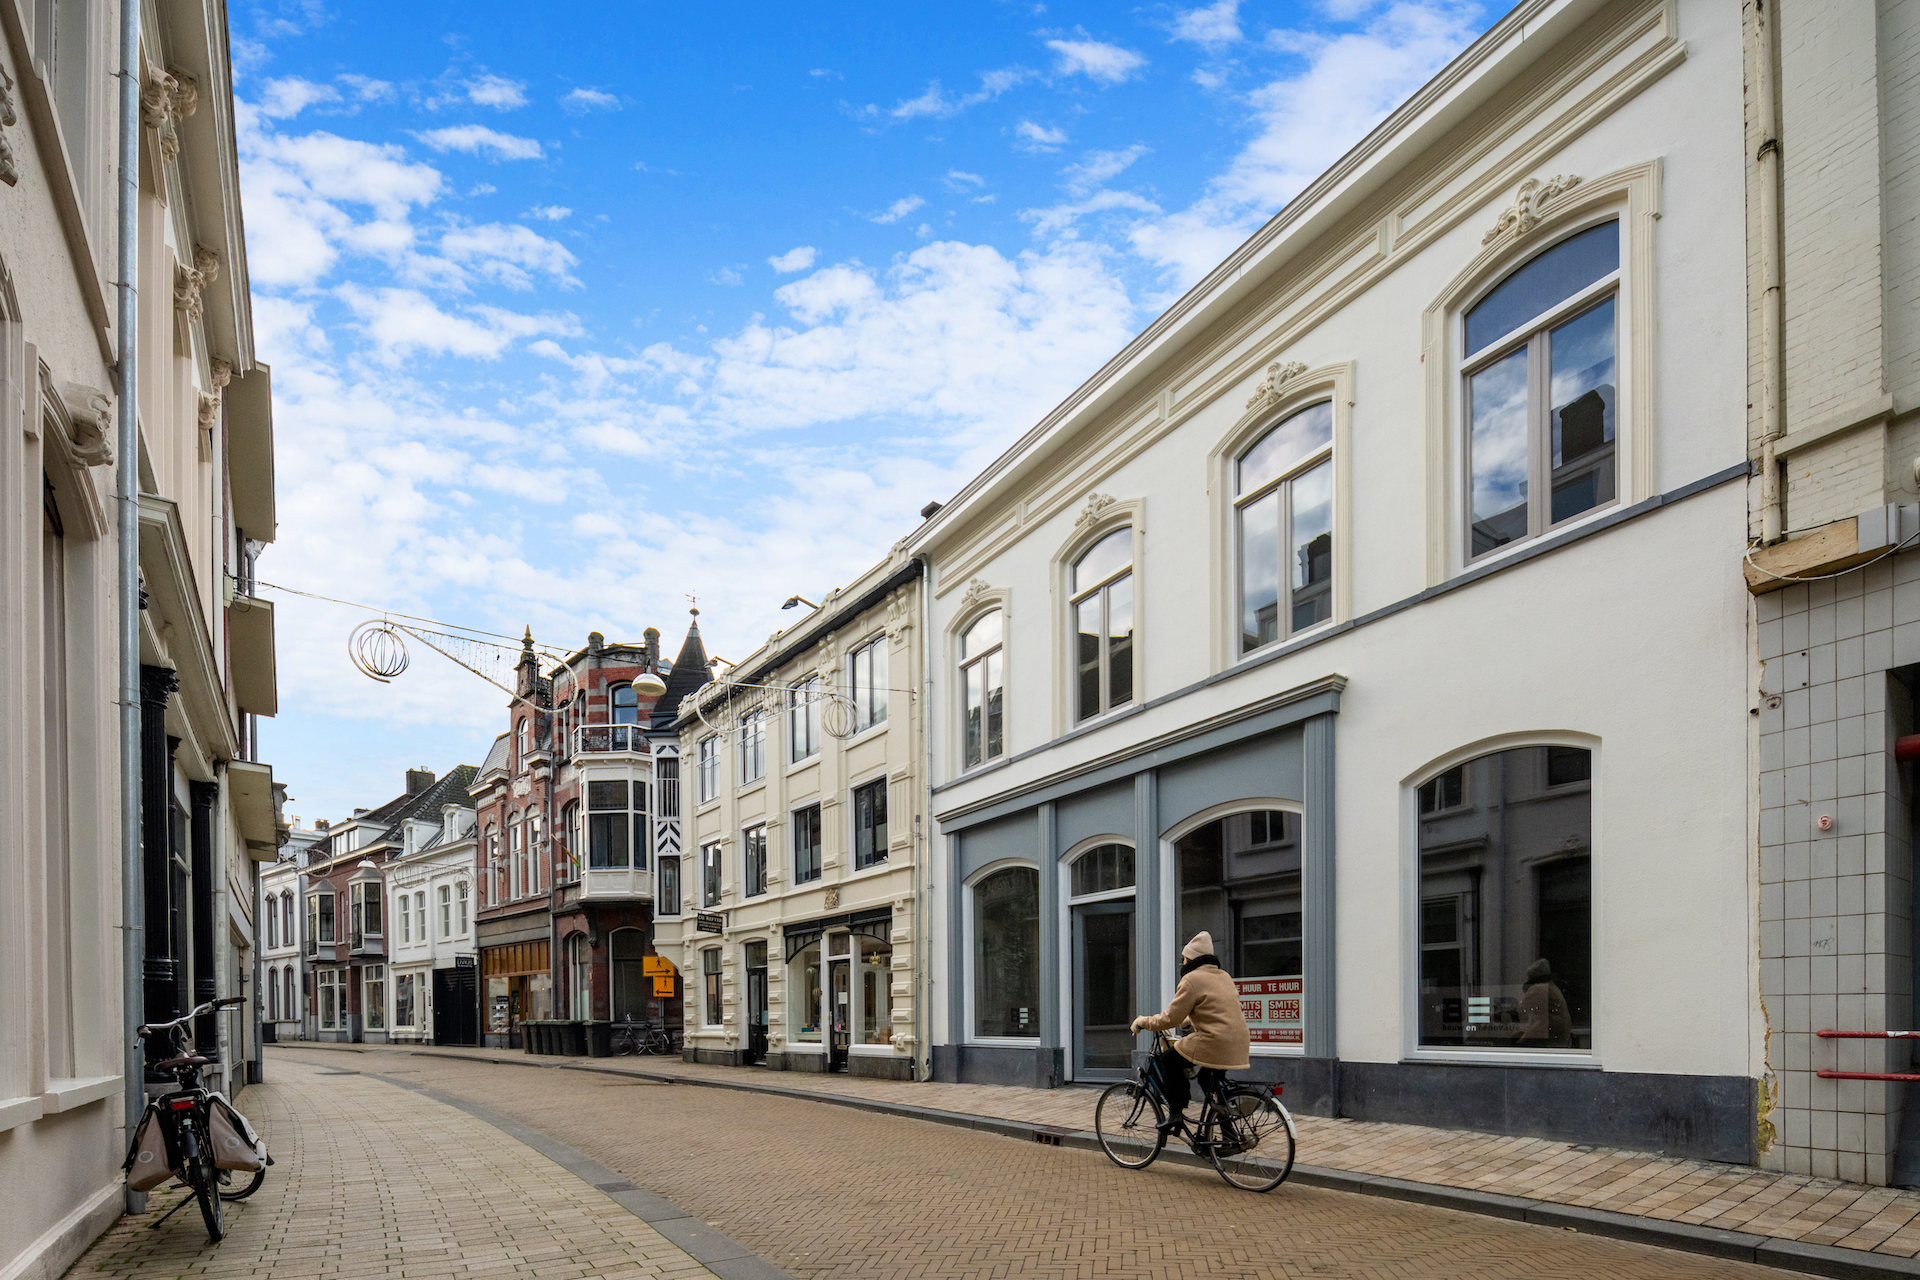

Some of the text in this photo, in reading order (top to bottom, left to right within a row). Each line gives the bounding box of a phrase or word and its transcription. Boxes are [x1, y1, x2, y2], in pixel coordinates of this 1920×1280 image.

[1242, 984, 1262, 992] HUUR
[1267, 982, 1300, 992] TE HUUR
[1240, 1002, 1261, 1010] MITS
[1269, 1000, 1298, 1009] SMITS
[1244, 1010, 1260, 1018] EEK
[1273, 1010, 1298, 1018] BEEK
